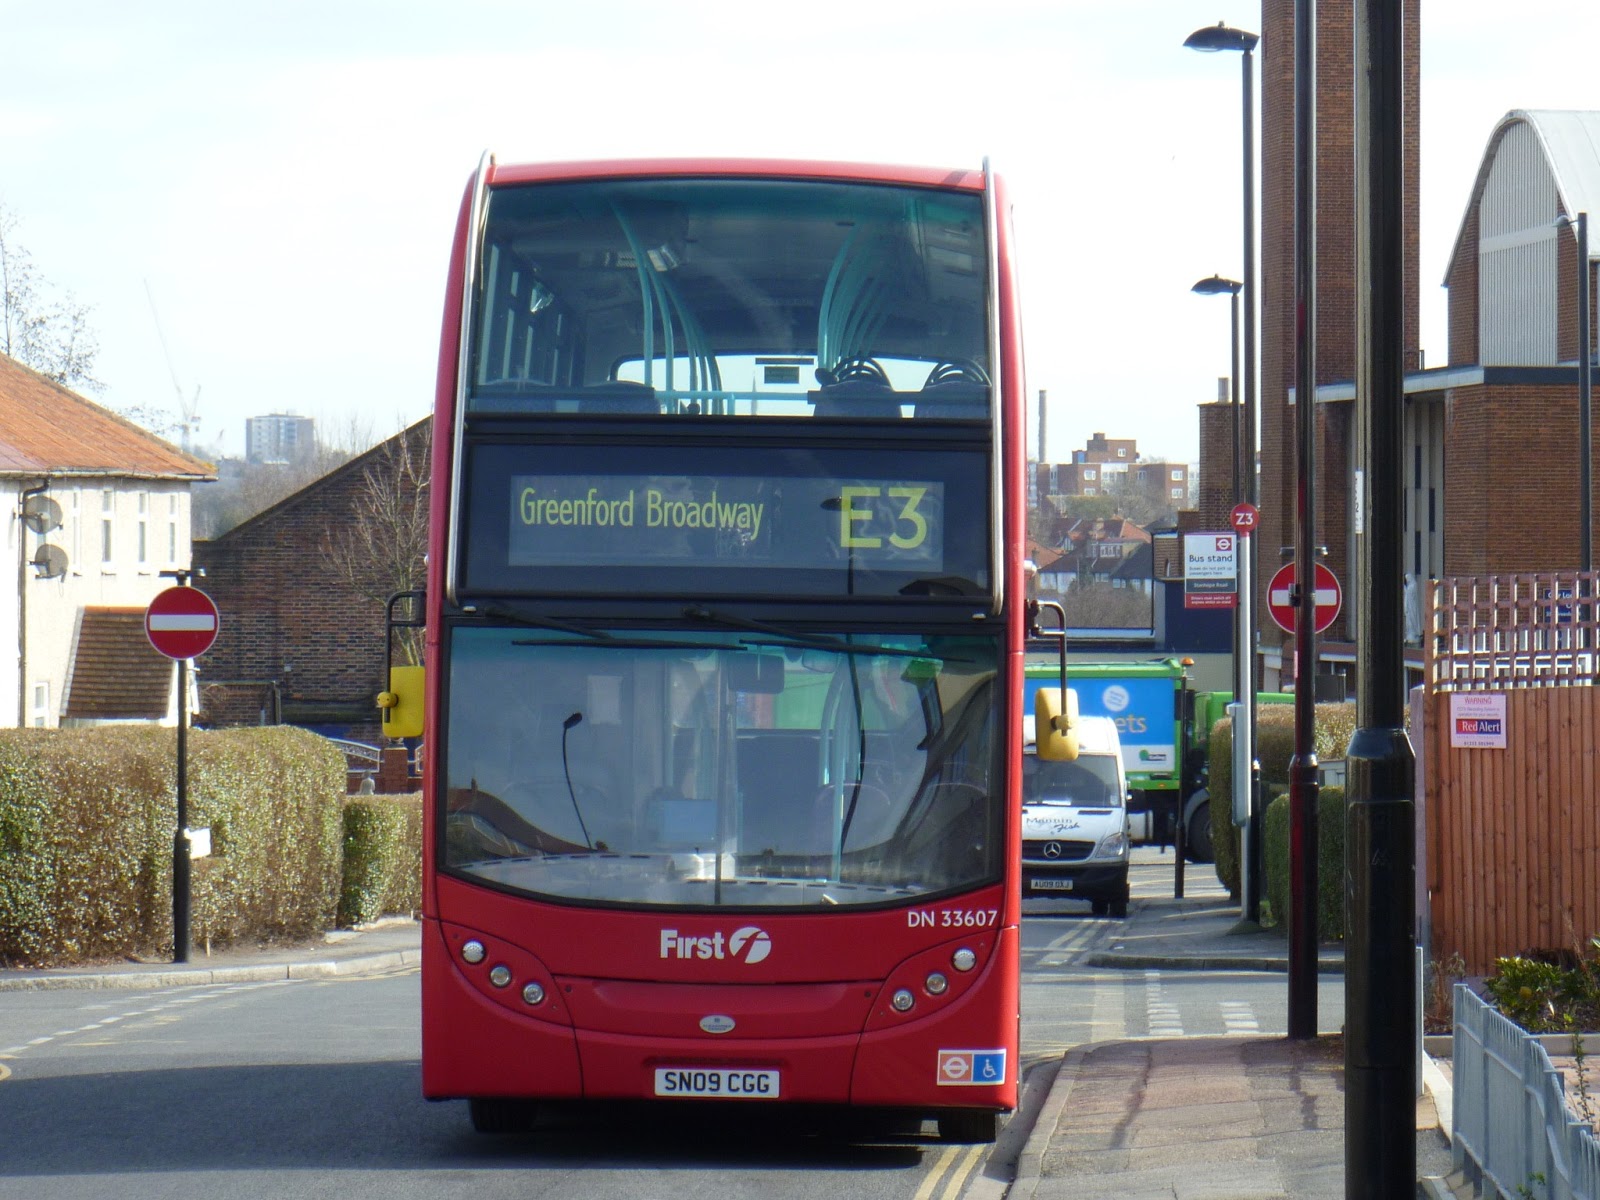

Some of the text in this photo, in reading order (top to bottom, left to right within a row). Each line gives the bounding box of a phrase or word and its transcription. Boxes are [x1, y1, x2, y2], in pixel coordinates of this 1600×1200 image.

[520, 488, 764, 540] Greenford Broadway
[839, 485, 927, 549] E3
[1235, 512, 1254, 525] Z3
[1462, 721, 1500, 732] Red Alert
[907, 910, 998, 928] DN 33607
[660, 929, 725, 960] First
[664, 1071, 770, 1092] SN09 CGG
